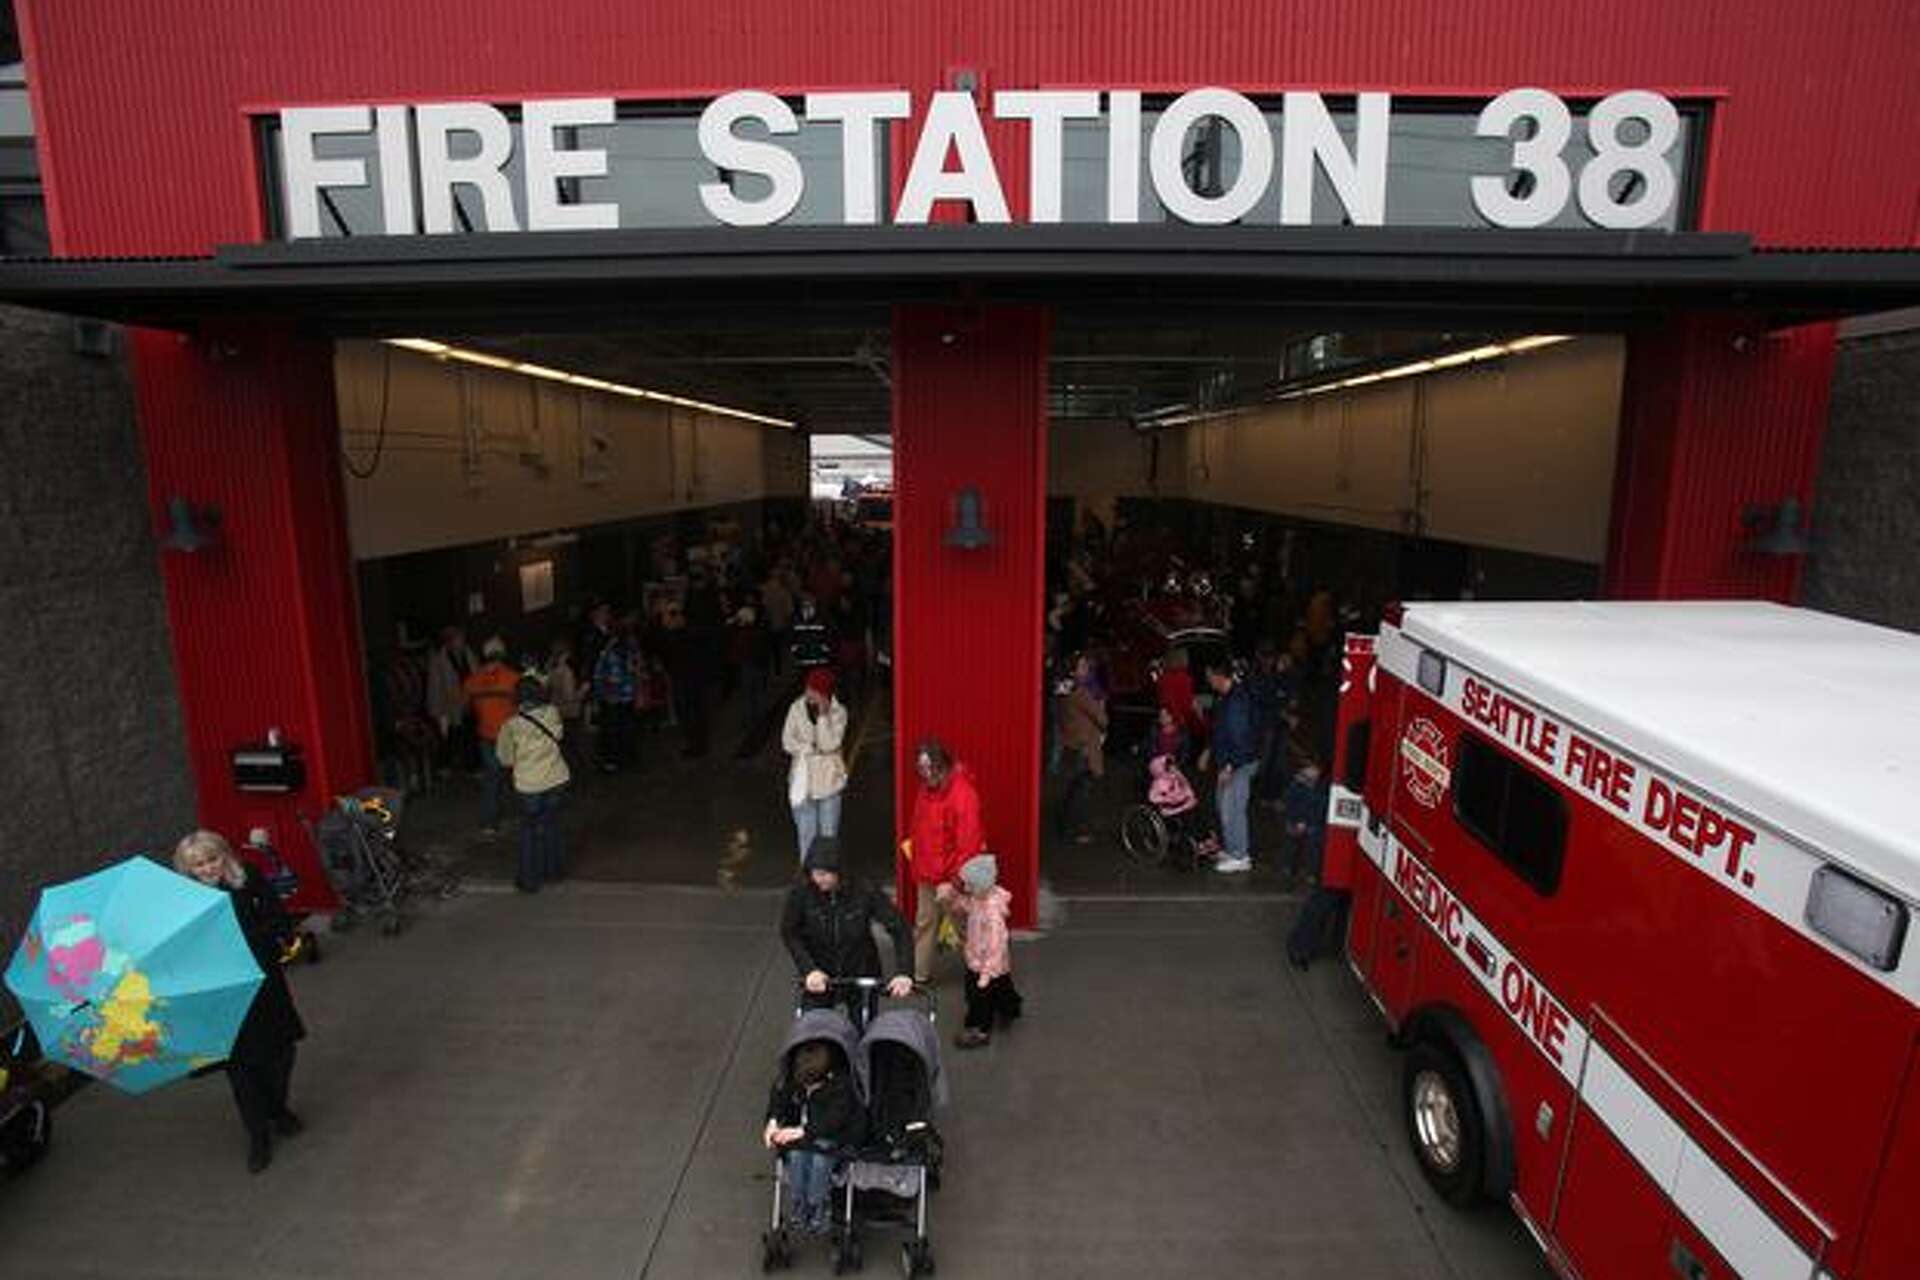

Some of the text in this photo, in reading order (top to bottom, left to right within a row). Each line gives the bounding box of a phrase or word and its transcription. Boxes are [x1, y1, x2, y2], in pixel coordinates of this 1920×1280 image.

[280, 87, 1681, 238] FIRE STATION 38
[1461, 677, 1559, 765] SEATTLE
[1565, 733, 1636, 812] FIRE
[1643, 777, 1757, 888] DEPT.
[1393, 847, 1464, 947] MEDIC
[1501, 961, 1571, 1063] ONE
